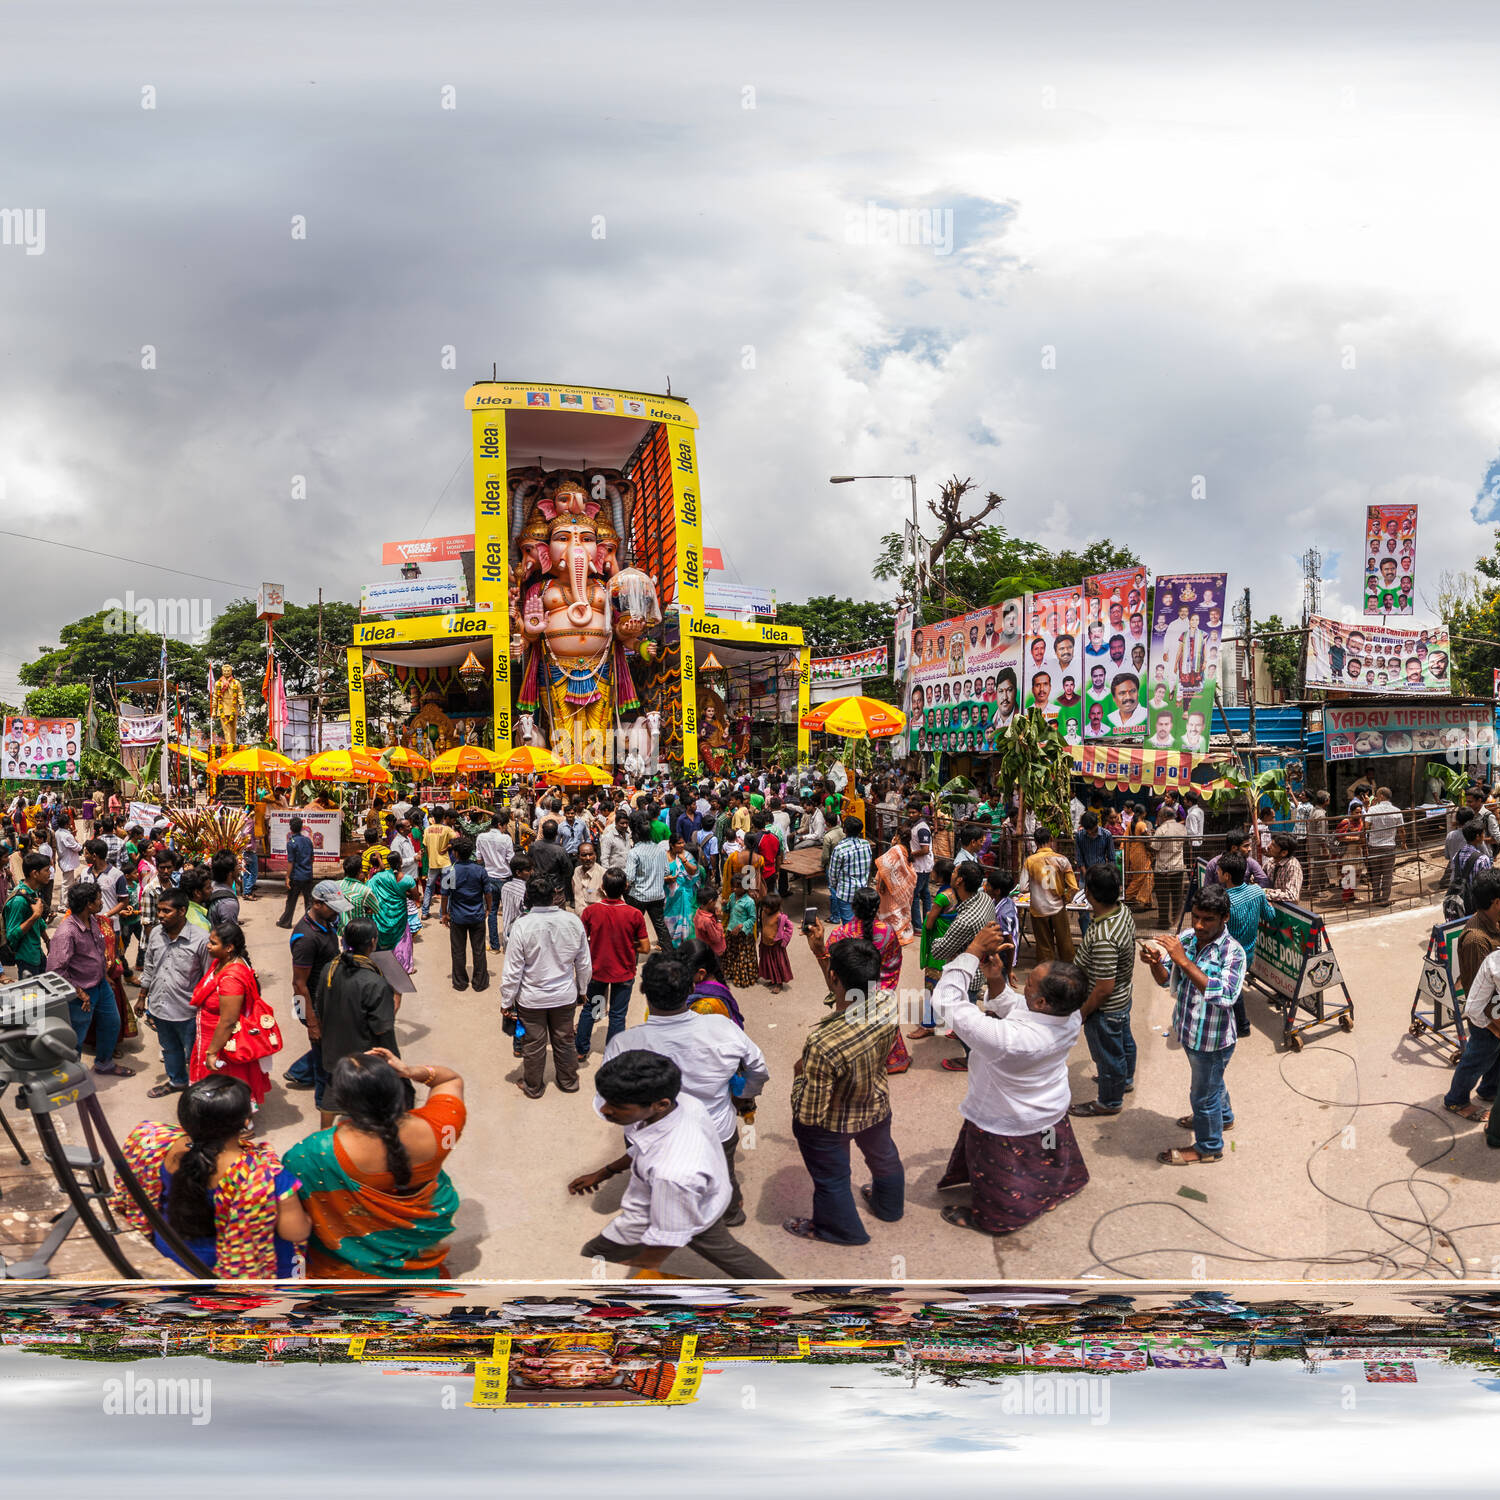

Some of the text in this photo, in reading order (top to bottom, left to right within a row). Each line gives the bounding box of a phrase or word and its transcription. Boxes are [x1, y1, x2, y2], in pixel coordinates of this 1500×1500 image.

[431, 594, 458, 605] meil
[752, 604, 772, 614] meil
[1362, 626, 1385, 634] GANESH
[1330, 709, 1490, 730] YADAV TIFFIN CENTER
[1073, 760, 1140, 776] MIRCHI
[1270, 972, 1293, 993] POLIC
